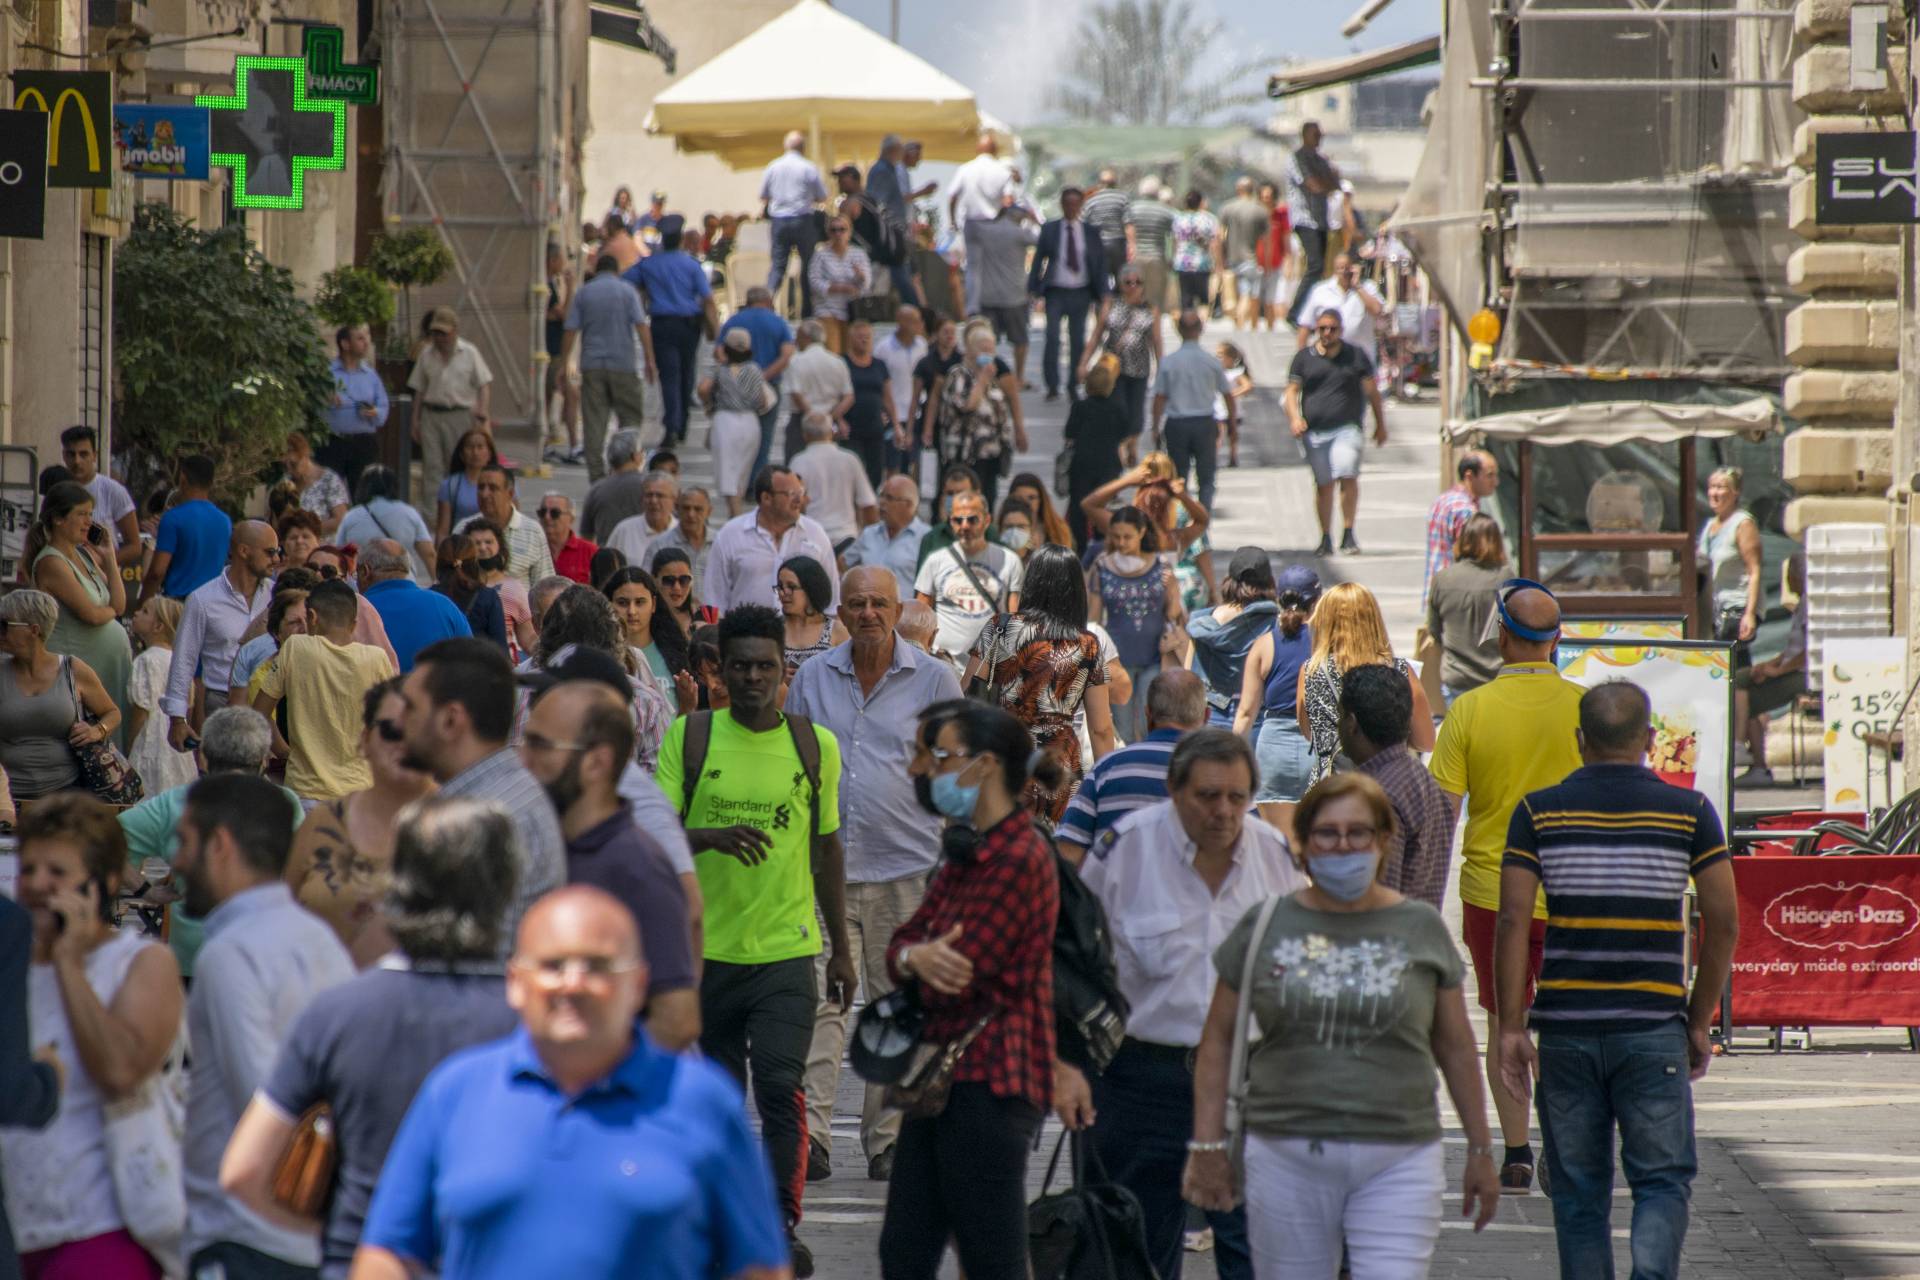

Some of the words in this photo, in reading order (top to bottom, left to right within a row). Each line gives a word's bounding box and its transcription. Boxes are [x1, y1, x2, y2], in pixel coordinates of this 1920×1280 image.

[1851, 690, 1904, 716] 15%
[711, 796, 773, 814] Standard
[706, 811, 771, 831] Chartered
[1804, 958, 1847, 972] mäde
